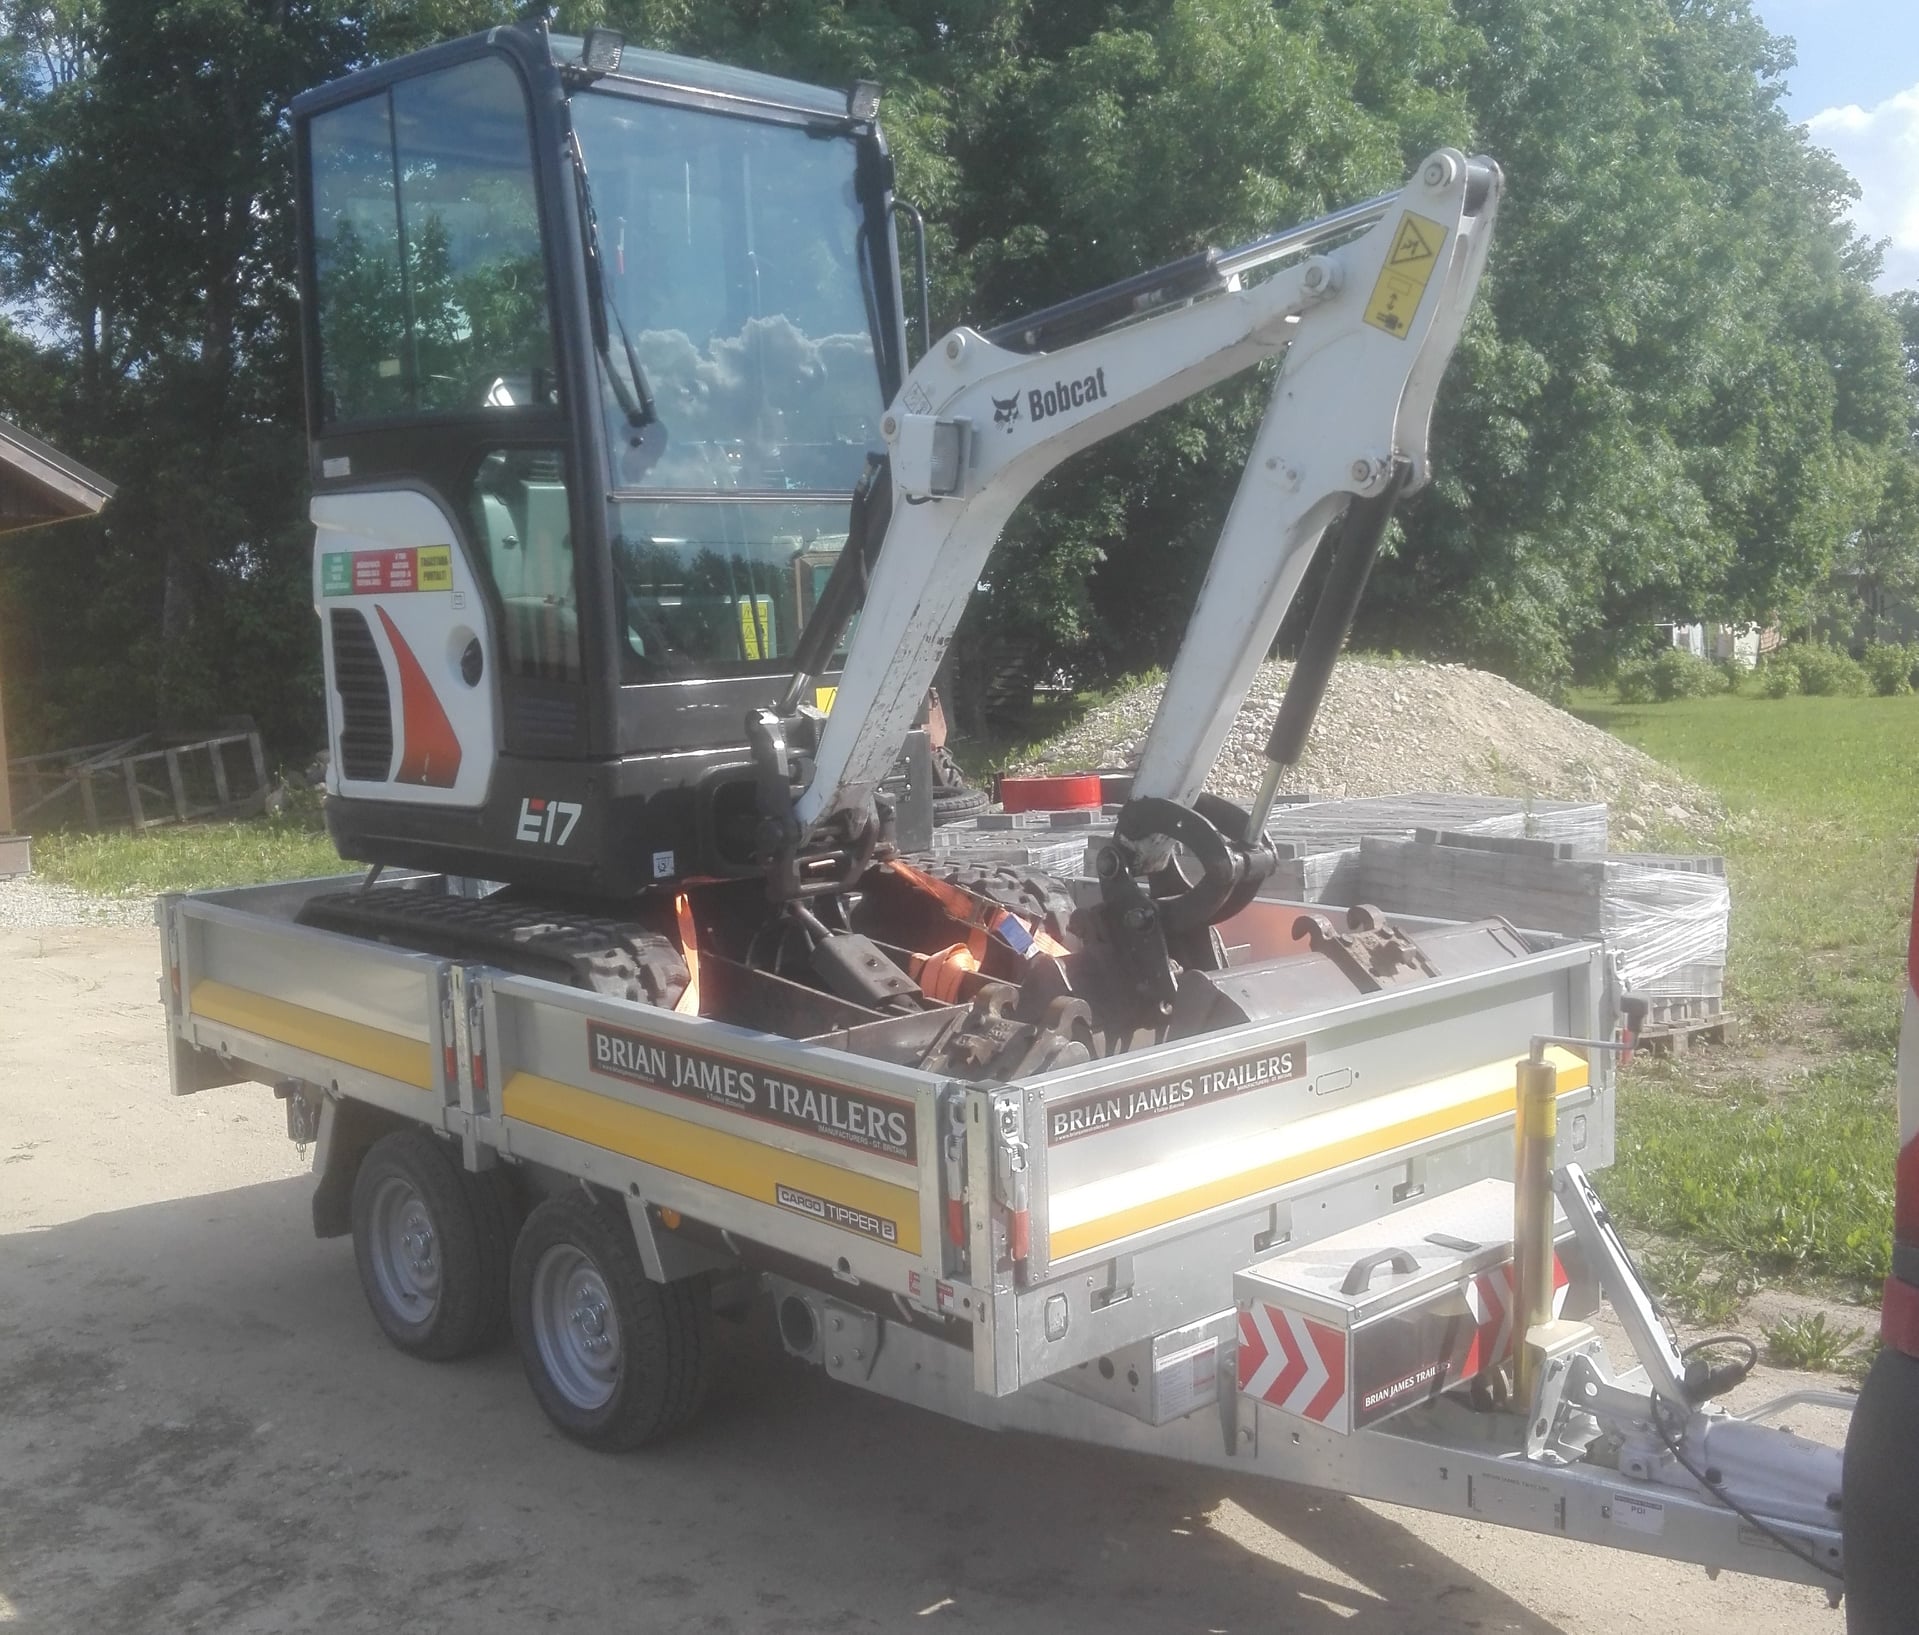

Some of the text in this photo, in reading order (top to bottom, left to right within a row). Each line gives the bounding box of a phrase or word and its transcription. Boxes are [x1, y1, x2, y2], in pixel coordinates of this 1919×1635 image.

[1028, 367, 1107, 422] Bobcat
[516, 798, 582, 846] E17
[596, 1032, 908, 1147] BRIAN JAMES TRAILERS
[1053, 1053, 1293, 1136] BRIAN JAMES TRAILERS
[781, 1190, 822, 1212] CARGO
[826, 1203, 879, 1234] TIPPER
[1365, 1387, 1389, 1408] BRIAN
[1389, 1376, 1415, 1398] JAMES
